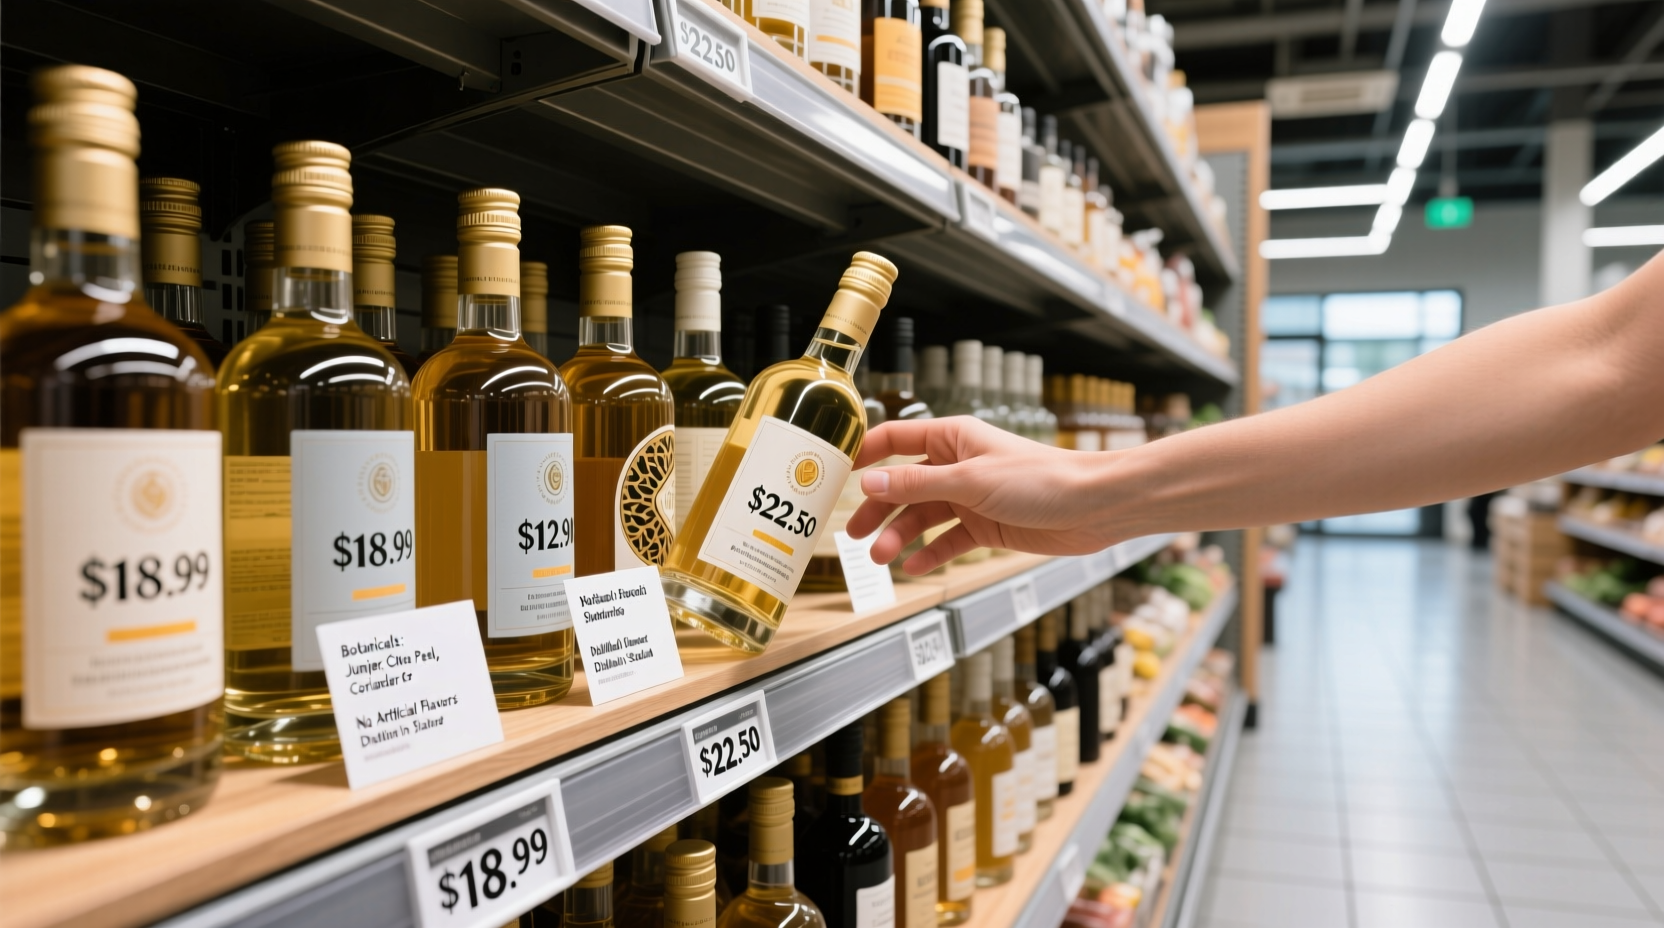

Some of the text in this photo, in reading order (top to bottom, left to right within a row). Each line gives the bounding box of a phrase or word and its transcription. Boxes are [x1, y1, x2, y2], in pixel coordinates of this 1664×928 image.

[748, 485, 817, 538] $22.50
[333, 529, 413, 572] $18.99
[79, 550, 209, 609] $18.99
[700, 726, 760, 778] $22.50
[438, 827, 548, 914] $18.99
